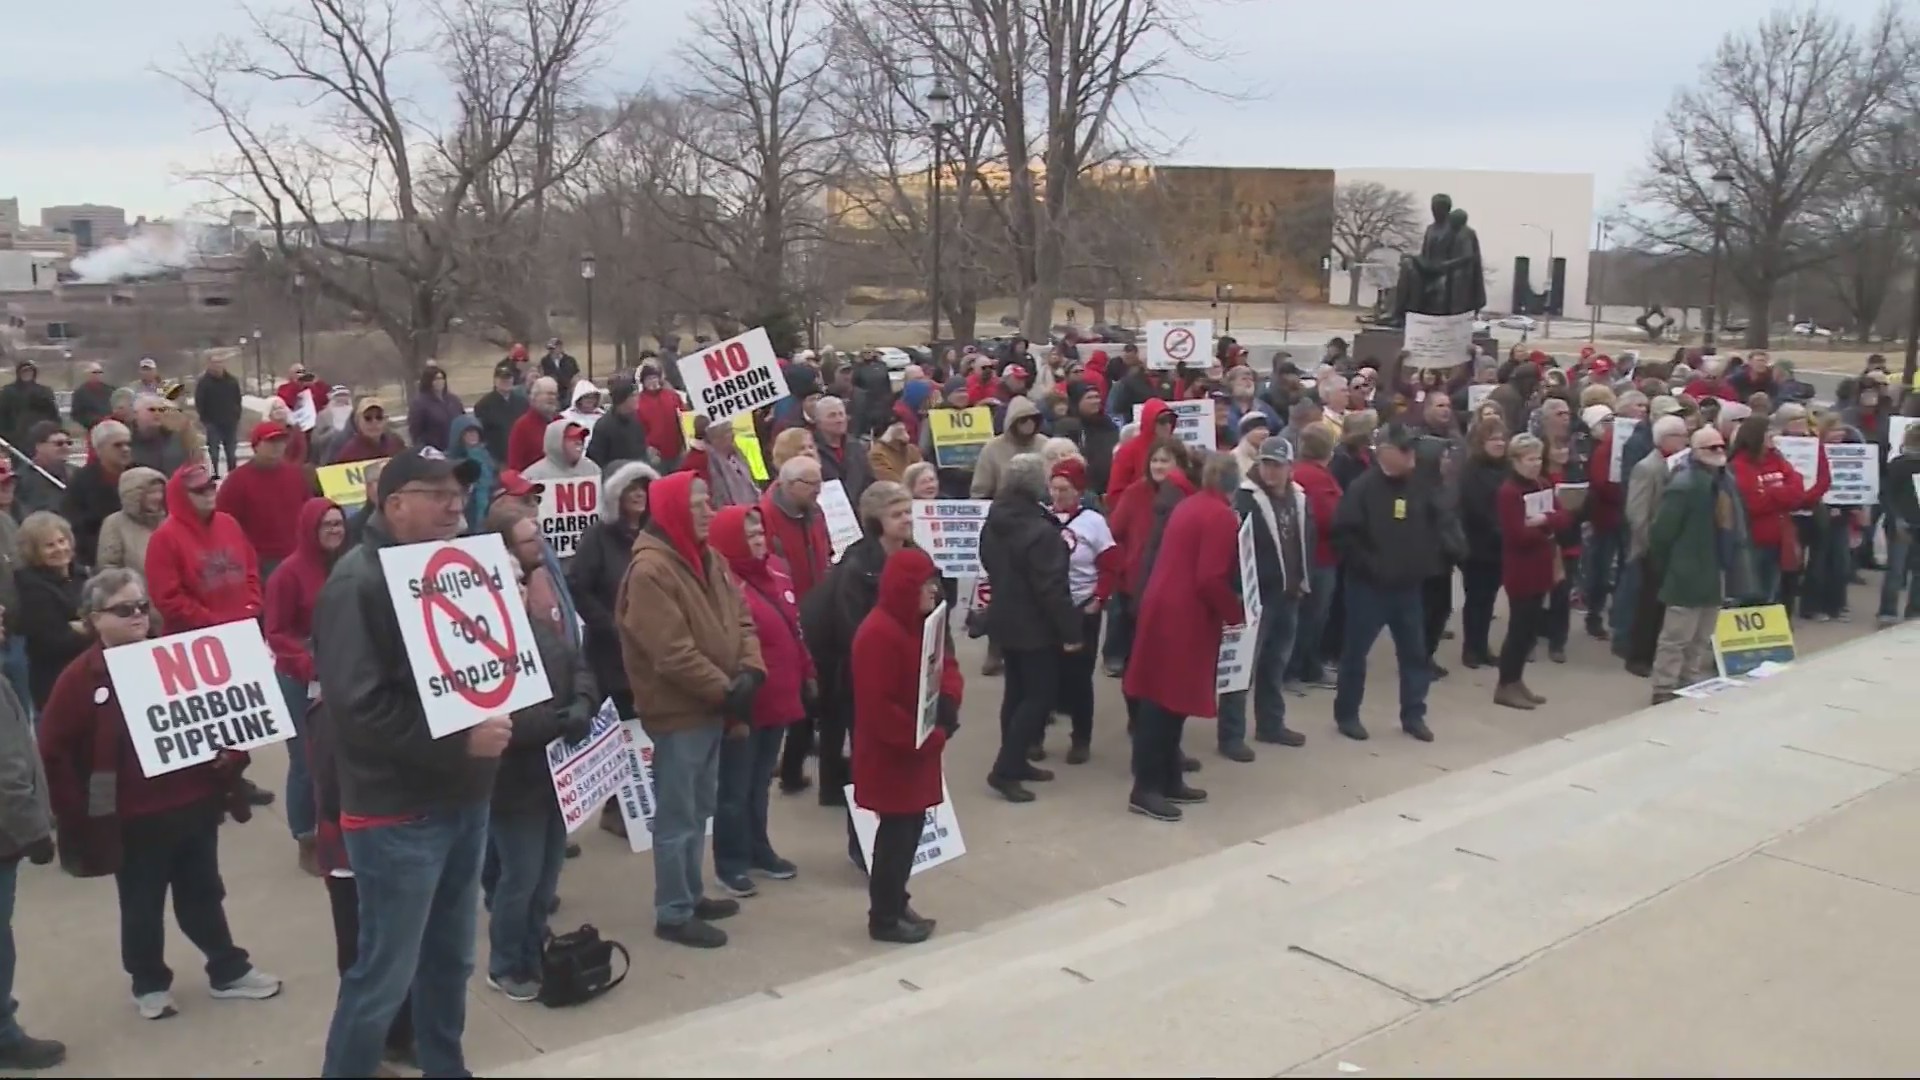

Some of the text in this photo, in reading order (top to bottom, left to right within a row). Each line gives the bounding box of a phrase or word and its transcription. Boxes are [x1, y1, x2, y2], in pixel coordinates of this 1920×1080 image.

[703, 342, 750, 381] NO
[702, 366, 771, 404] CARBON
[707, 381, 779, 422] PIPELINE
[950, 413, 973, 428] NO
[555, 481, 596, 513] NO
[543, 508, 599, 529] CARBO
[408, 563, 504, 599] Pipelines
[1734, 612, 1765, 631] NO
[152, 636, 232, 696] NO
[429, 650, 538, 697] Hazardous
[146, 681, 267, 733] CARBON
[154, 710, 279, 764] PIPELINE
[557, 773, 573, 790] NO
[561, 789, 577, 808] NO
[566, 807, 582, 825] NO
